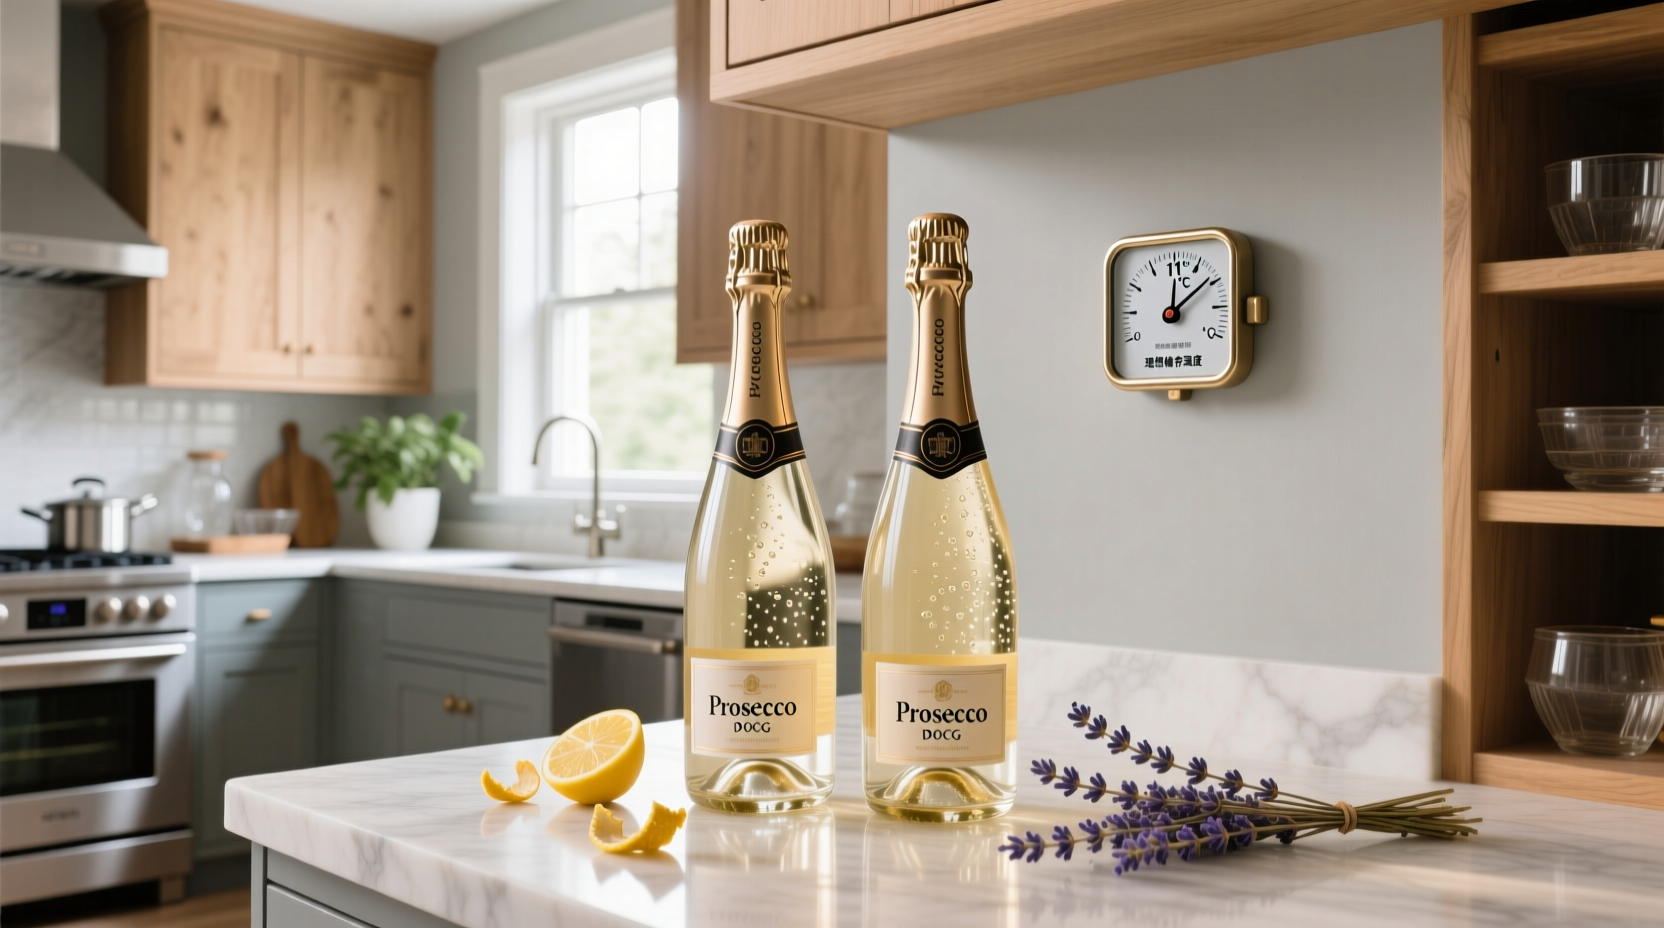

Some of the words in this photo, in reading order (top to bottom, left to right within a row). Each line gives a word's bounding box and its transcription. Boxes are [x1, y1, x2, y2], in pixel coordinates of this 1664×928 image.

[708, 695, 797, 716] Prosecco
[895, 701, 988, 724] Prosecco
[734, 722, 771, 733] DOCG
[922, 729, 962, 741] DOCG
